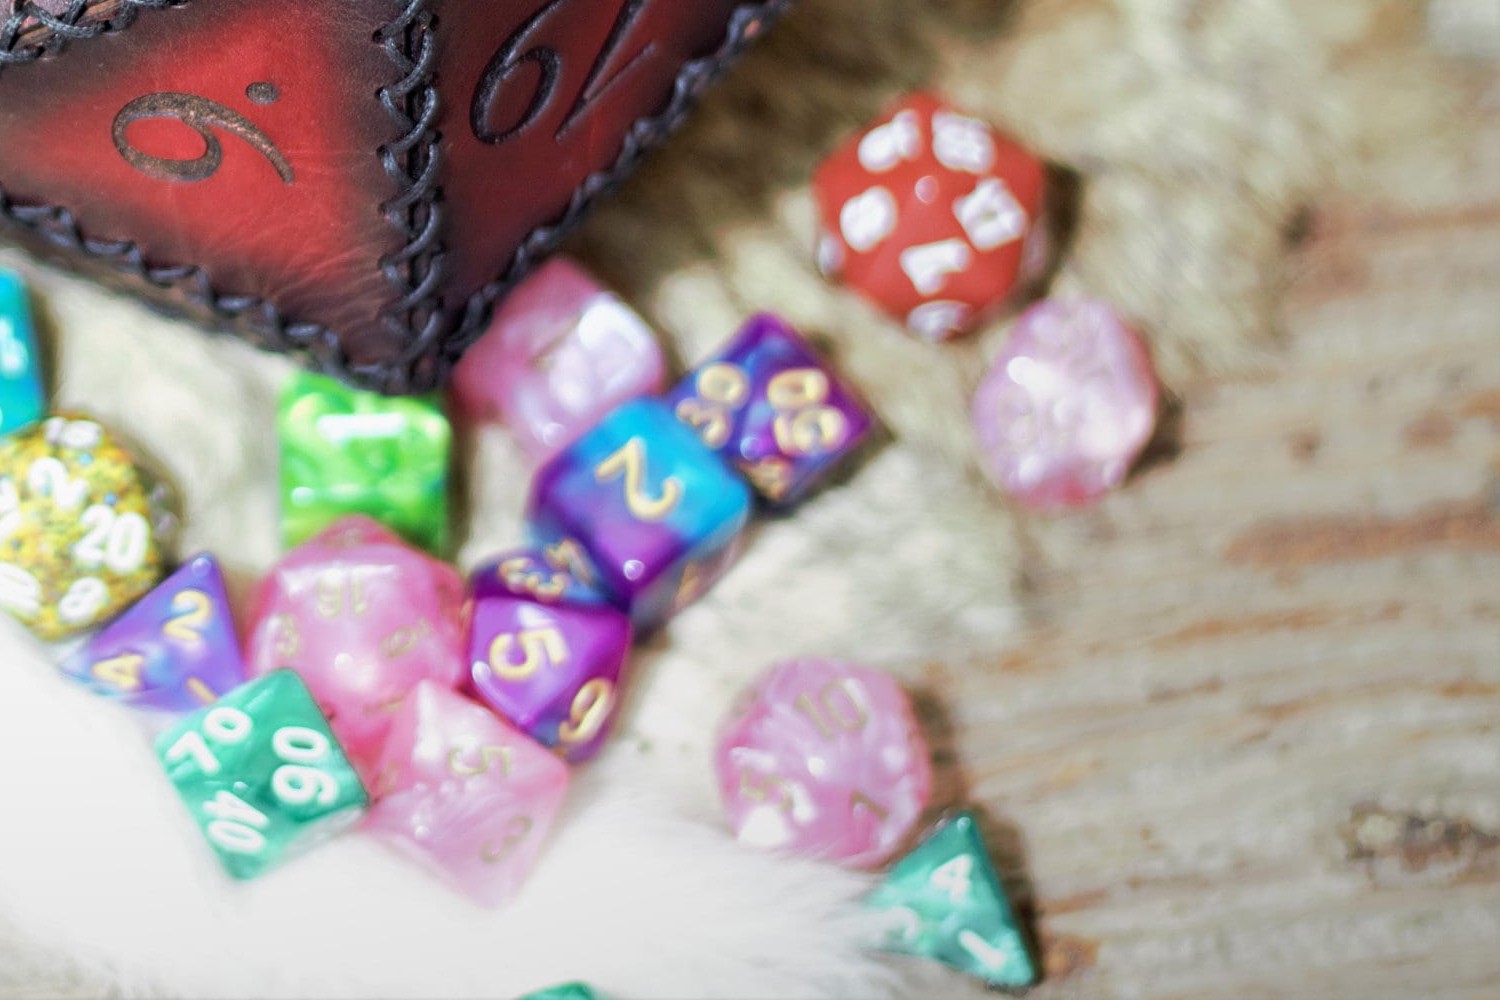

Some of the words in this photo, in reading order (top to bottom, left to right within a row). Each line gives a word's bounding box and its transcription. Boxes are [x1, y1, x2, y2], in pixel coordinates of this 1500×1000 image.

[28, 457, 89, 509] 2
[595, 437, 683, 520] 2
[75, 504, 150, 574] 20
[58, 576, 111, 625] 8
[162, 588, 213, 641] 2
[91, 653, 145, 688] 4
[489, 627, 569, 682] 5
[794, 679, 869, 741] 10
[165, 707, 254, 775] 70
[272, 726, 338, 805] 90
[448, 745, 512, 778] 5
[202, 790, 270, 854] 40
[930, 854, 974, 906] 4
[958, 929, 1006, 968] 1
